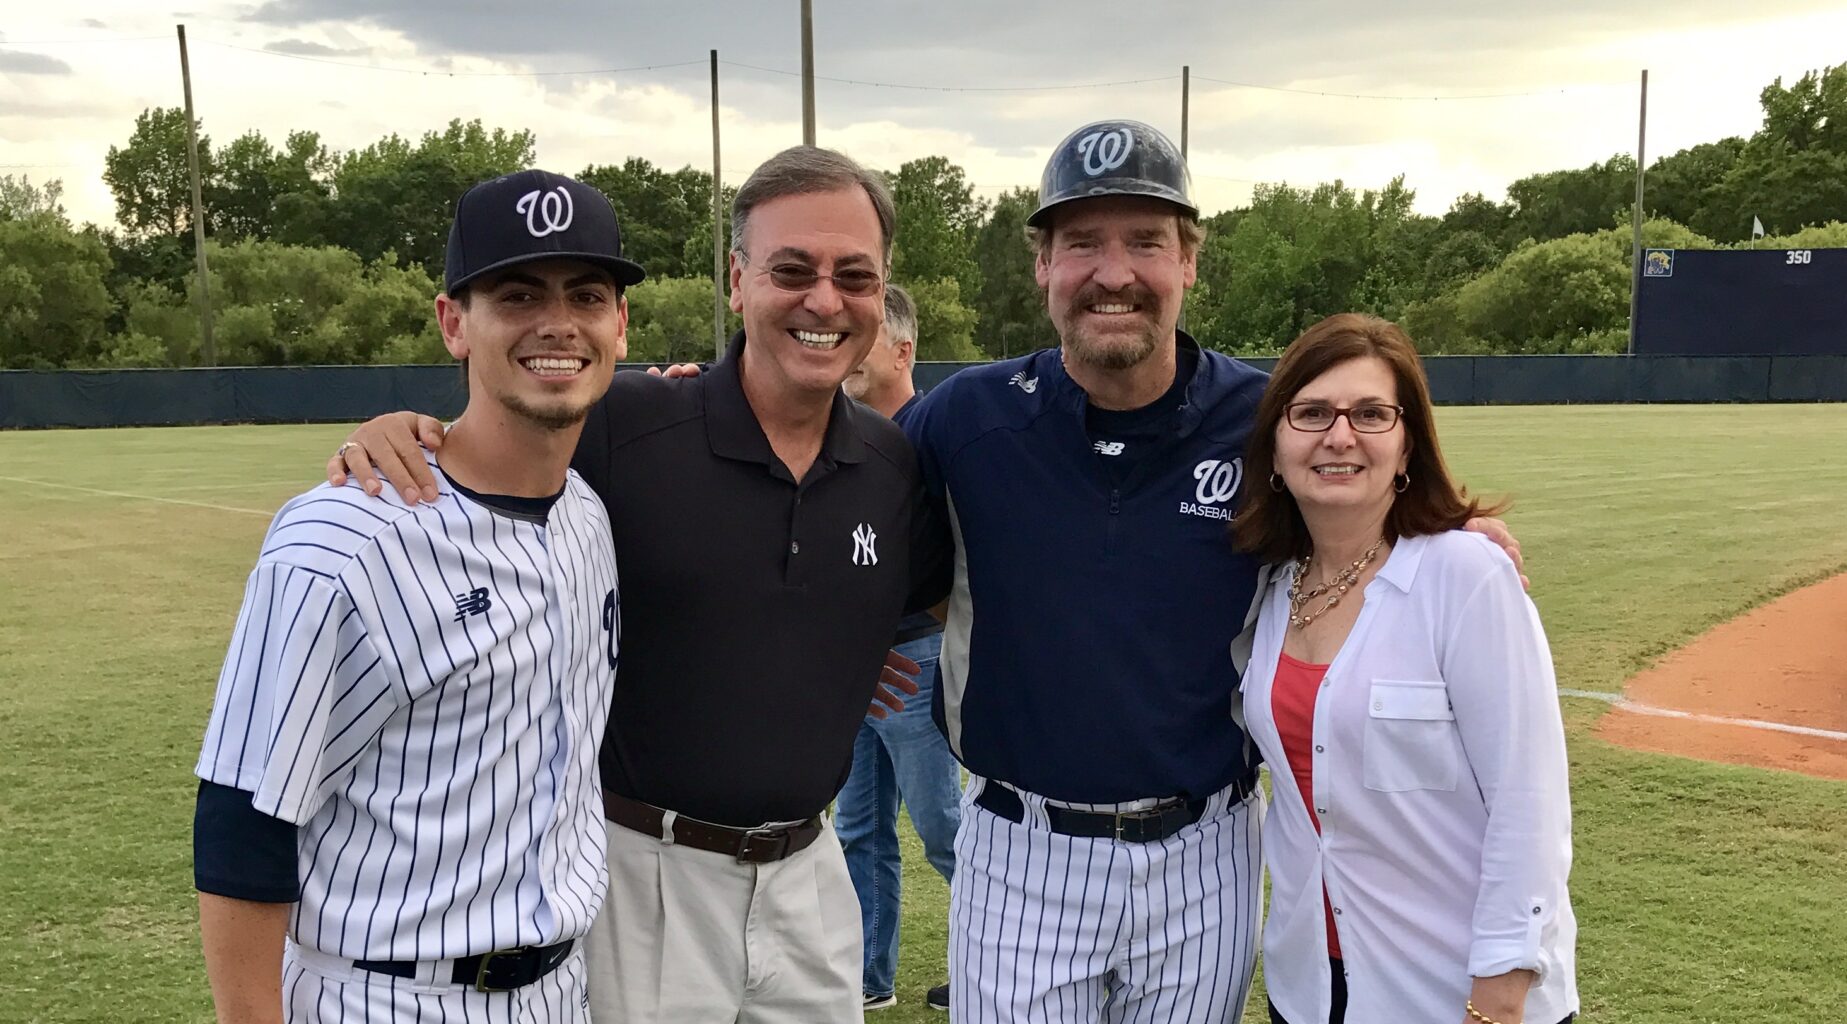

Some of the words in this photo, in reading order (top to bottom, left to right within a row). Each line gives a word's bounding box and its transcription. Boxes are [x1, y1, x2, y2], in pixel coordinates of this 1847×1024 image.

[1078, 128, 1133, 176] W
[516, 186, 573, 237] W
[1786, 250, 1811, 264] 350
[1193, 457, 1243, 505] W
[1179, 501, 1238, 522] BASEBAL
